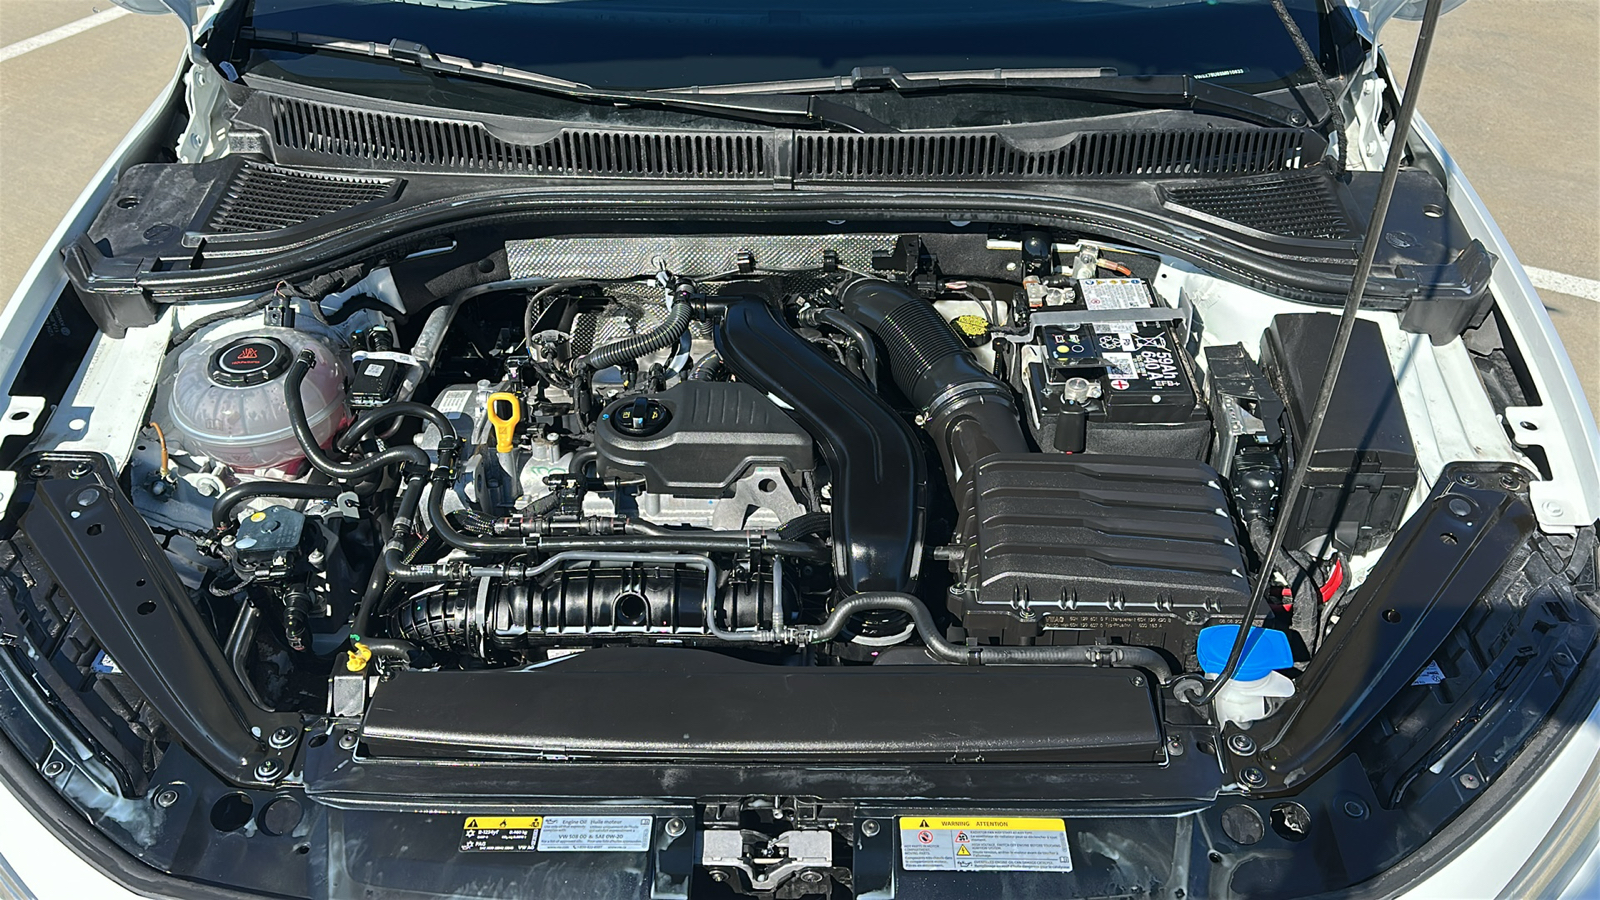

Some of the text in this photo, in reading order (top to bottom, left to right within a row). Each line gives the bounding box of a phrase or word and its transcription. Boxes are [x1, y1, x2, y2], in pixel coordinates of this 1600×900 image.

[1141, 351, 1164, 380] 640 A
[1156, 352, 1178, 379] 59Ah
